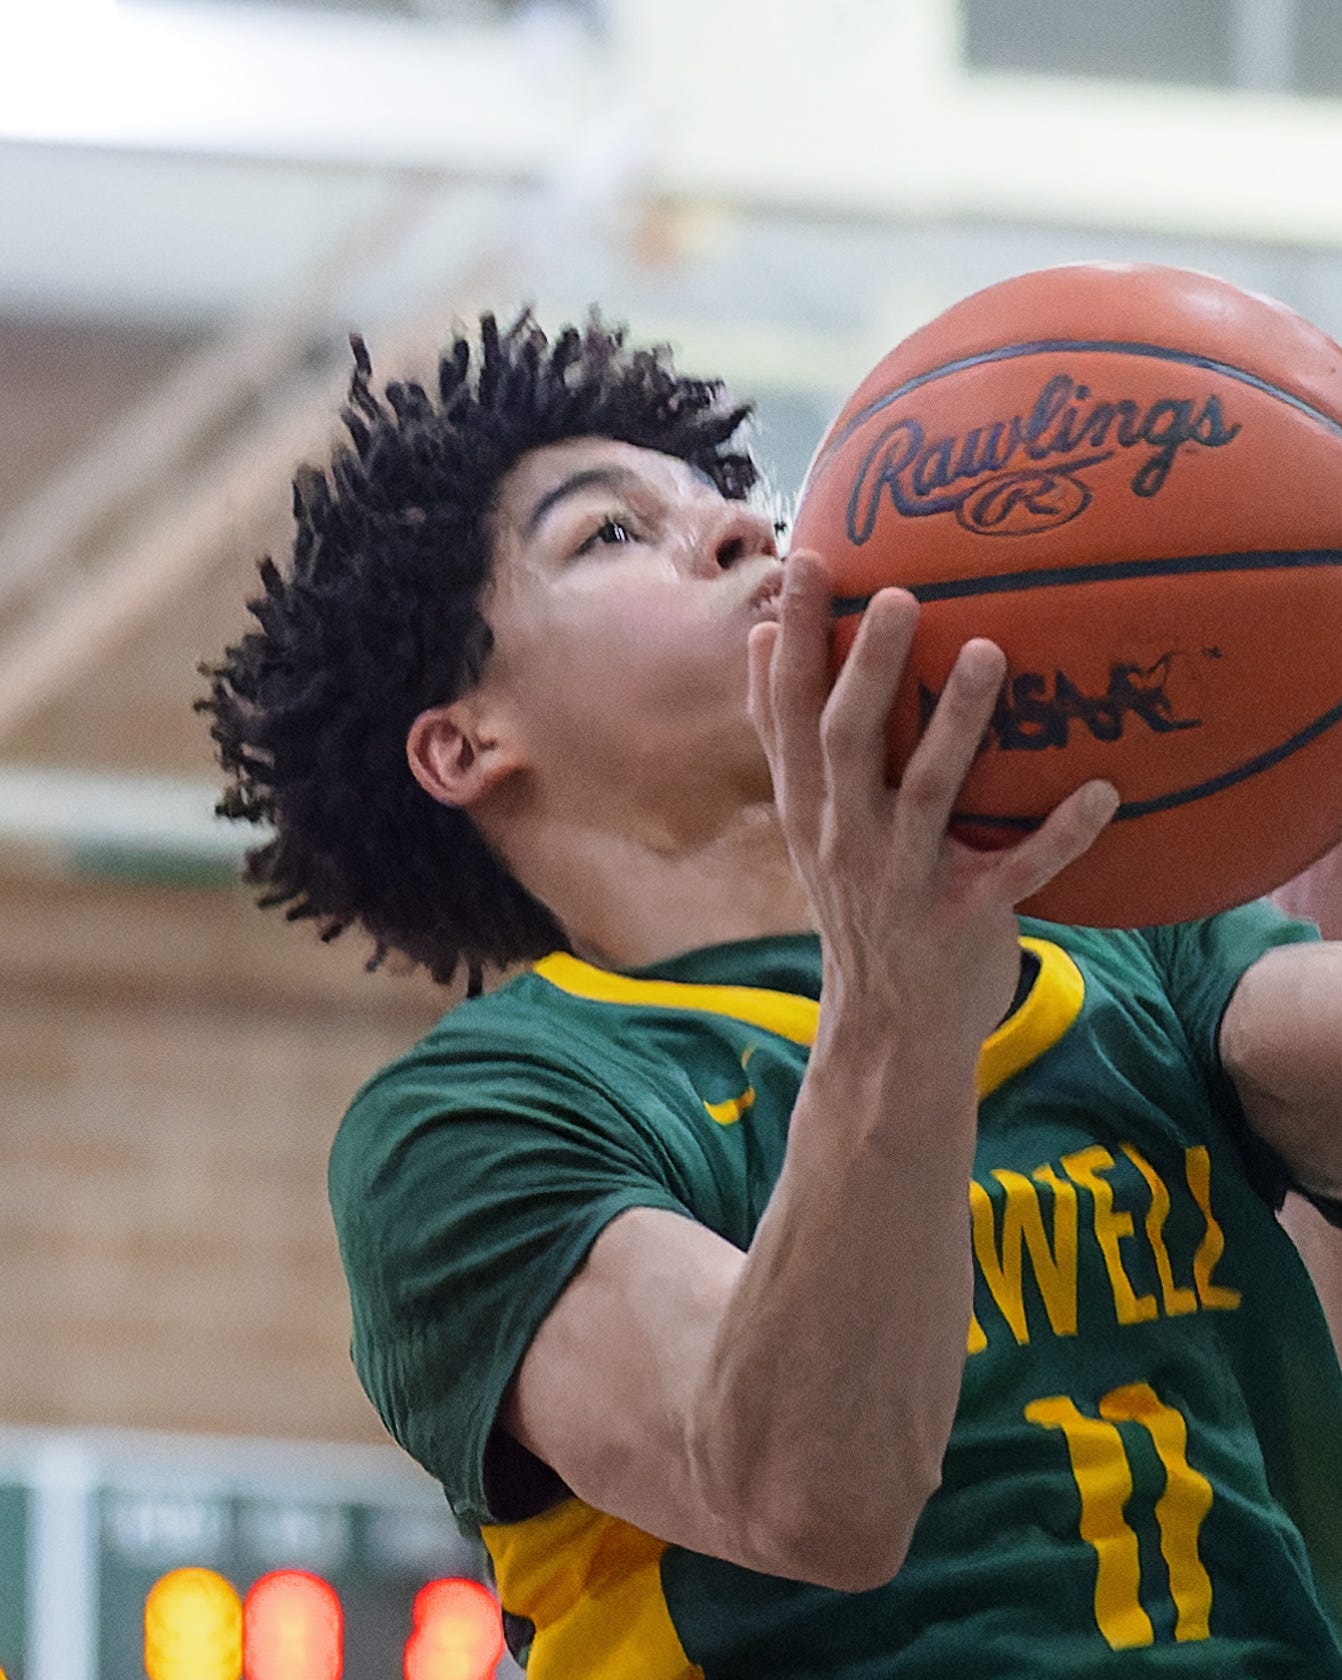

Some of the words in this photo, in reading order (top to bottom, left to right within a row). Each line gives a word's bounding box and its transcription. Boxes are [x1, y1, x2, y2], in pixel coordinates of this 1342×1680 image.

[846, 374, 1242, 546] Rawlings
[967, 1143, 1242, 1355] WELL
[1024, 1381, 1214, 1651] 11
